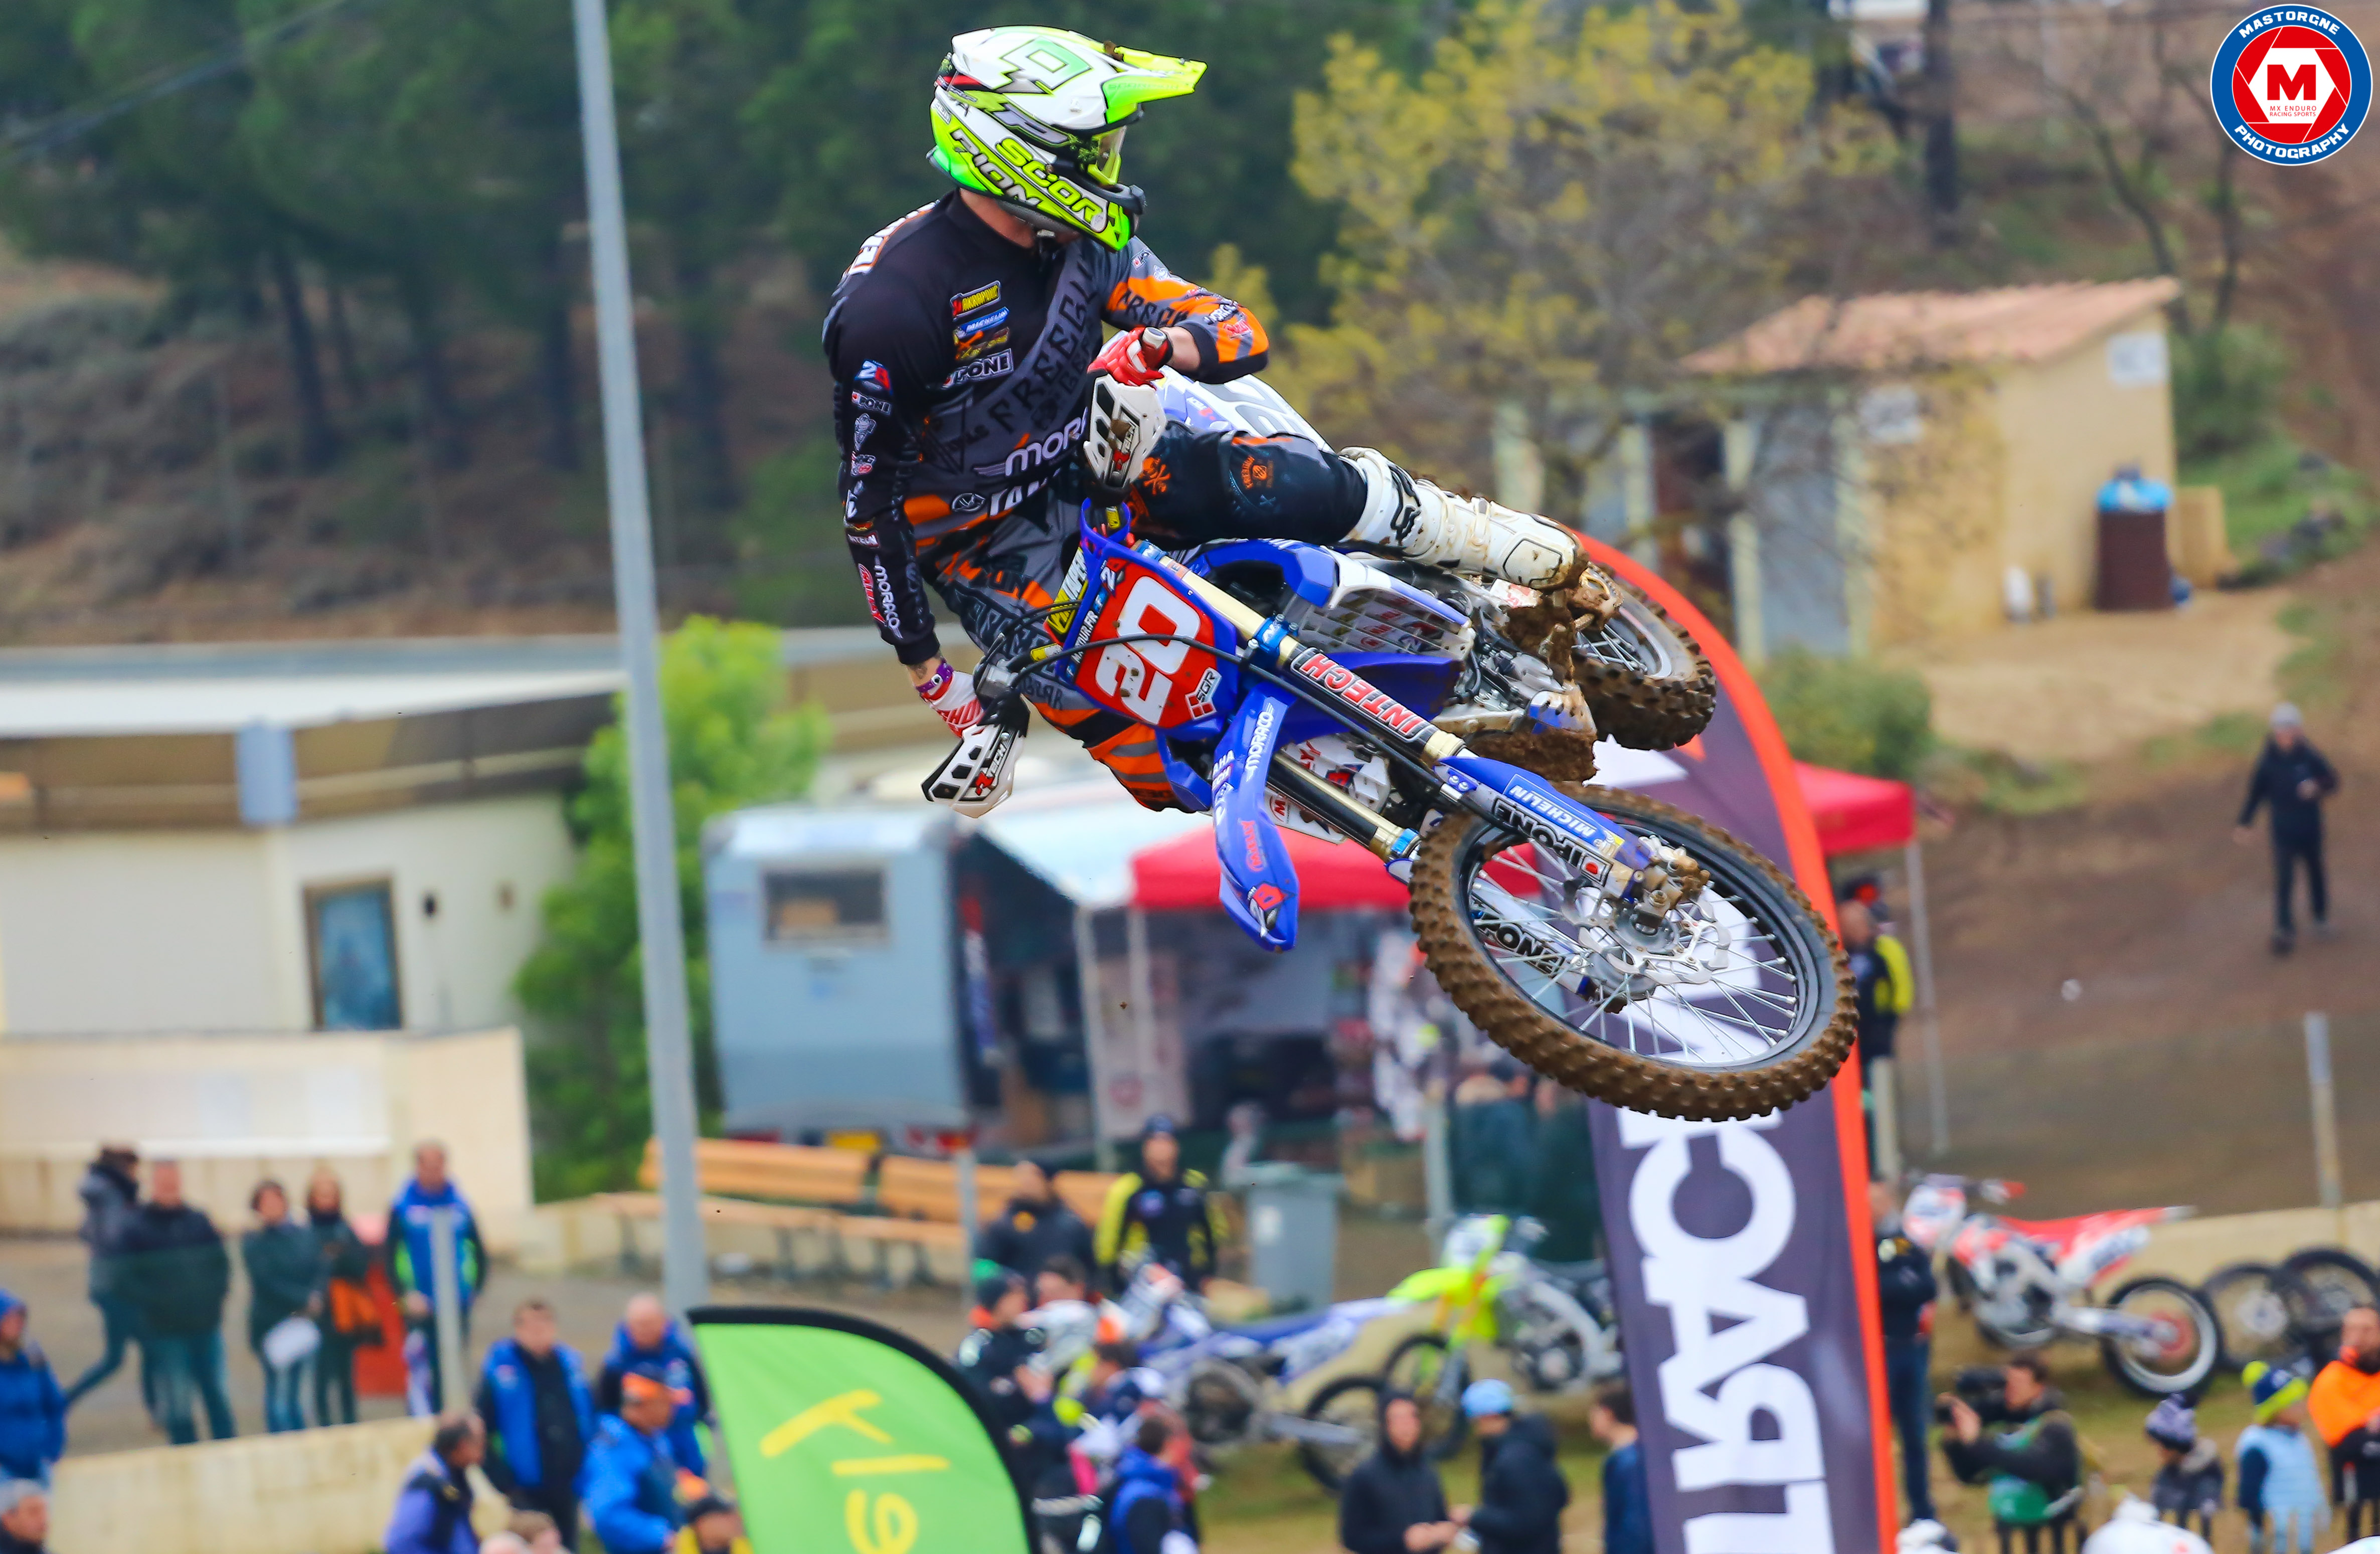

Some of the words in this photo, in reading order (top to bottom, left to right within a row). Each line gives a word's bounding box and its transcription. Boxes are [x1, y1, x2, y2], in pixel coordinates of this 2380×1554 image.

[1095, 575, 1201, 725] 20
[1300, 653, 1424, 736] INTECH
[1246, 711, 1275, 771] MORACO
[1496, 803, 1582, 870] IPONE
[1509, 784, 1597, 838] MICHELIN
